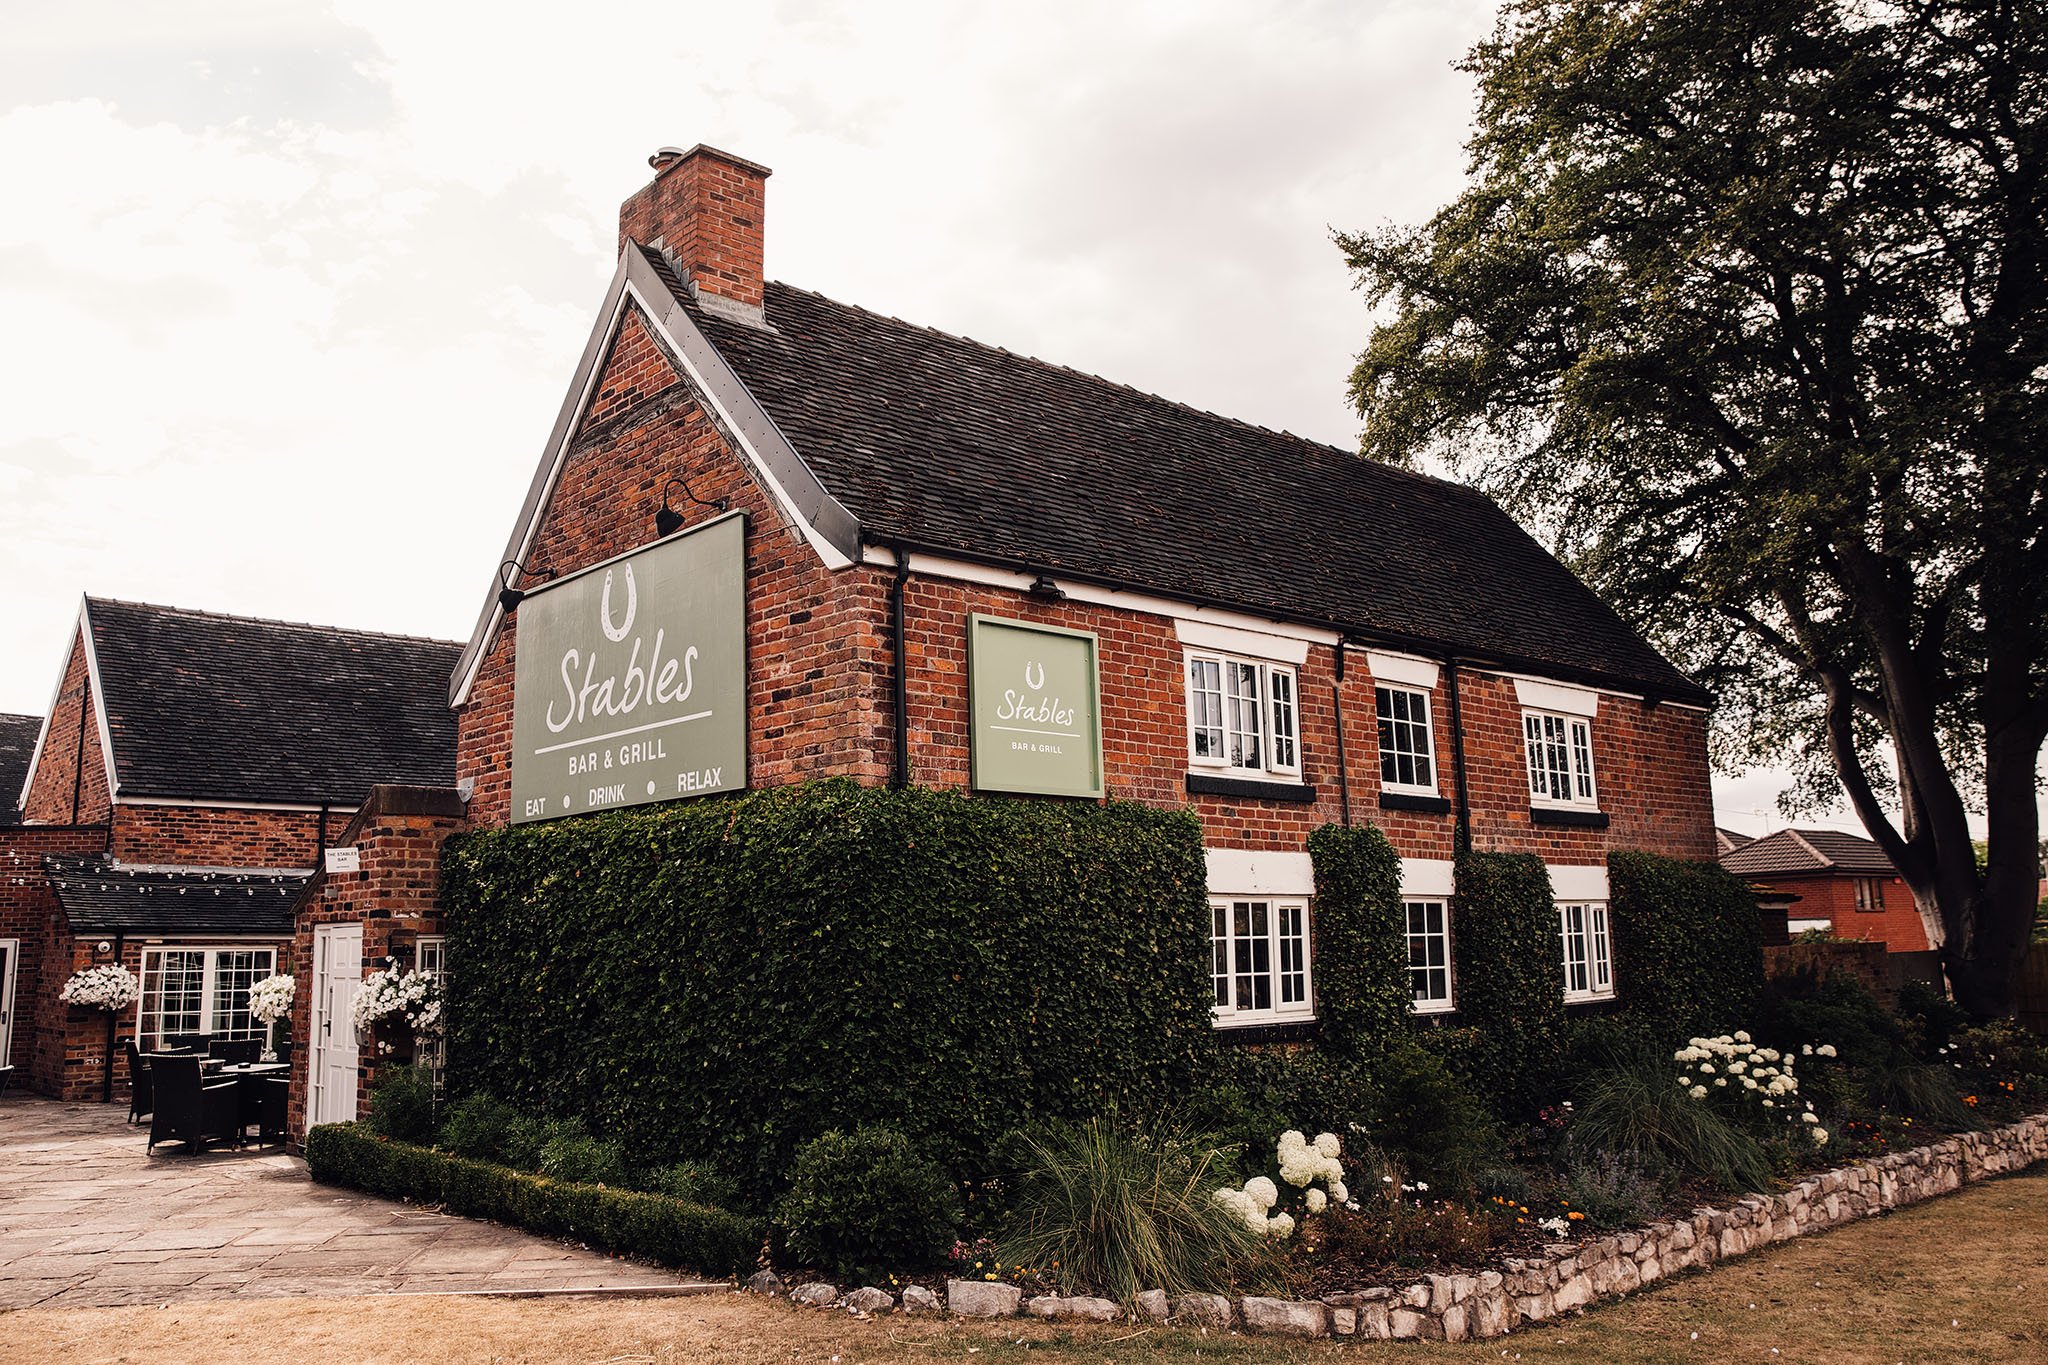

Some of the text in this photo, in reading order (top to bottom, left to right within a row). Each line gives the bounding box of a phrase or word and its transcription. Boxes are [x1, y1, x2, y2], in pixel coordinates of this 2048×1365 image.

[546, 628, 698, 733] Stables
[996, 689, 1074, 726] Stables
[569, 739, 666, 775] BAR & GRILL
[1011, 742, 1062, 754] BAR & GRILL
[525, 767, 722, 816] EAT DRINK RELAX
